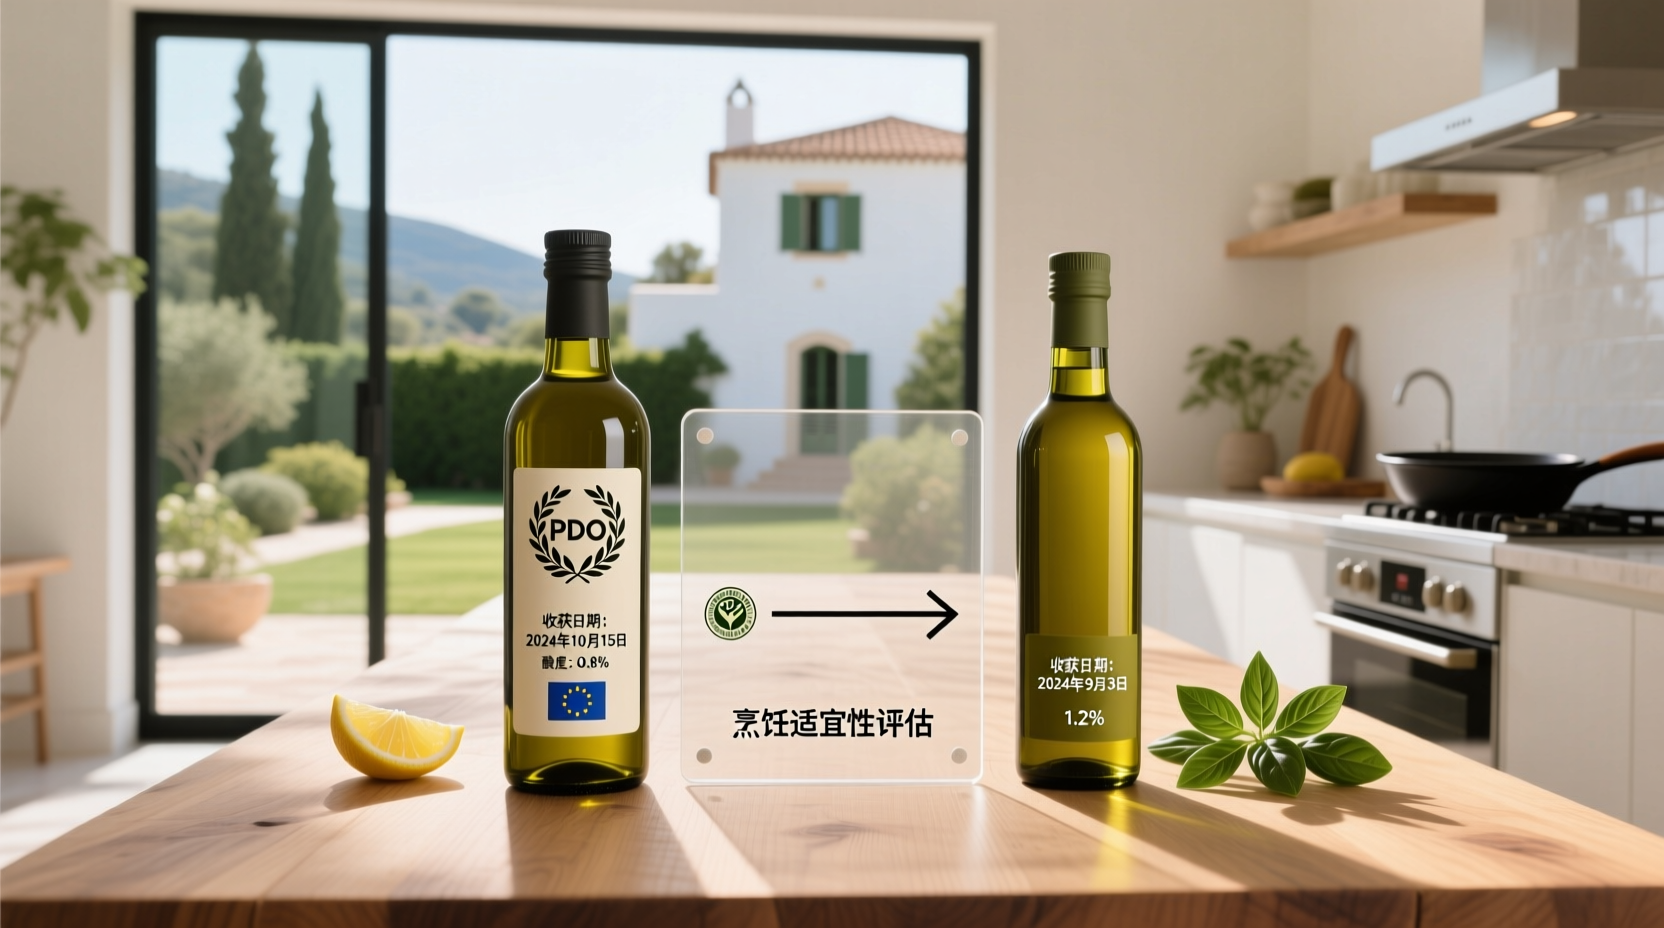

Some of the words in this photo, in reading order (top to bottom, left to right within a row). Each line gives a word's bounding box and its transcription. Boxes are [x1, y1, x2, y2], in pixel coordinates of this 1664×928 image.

[550, 518, 608, 542] PDO
[526, 632, 627, 649] 2024年10月15日
[1037, 674, 1128, 693] 2024年9月3日
[732, 707, 934, 739] 烹饪适宜性评估
[1064, 709, 1105, 726] 1.2%
